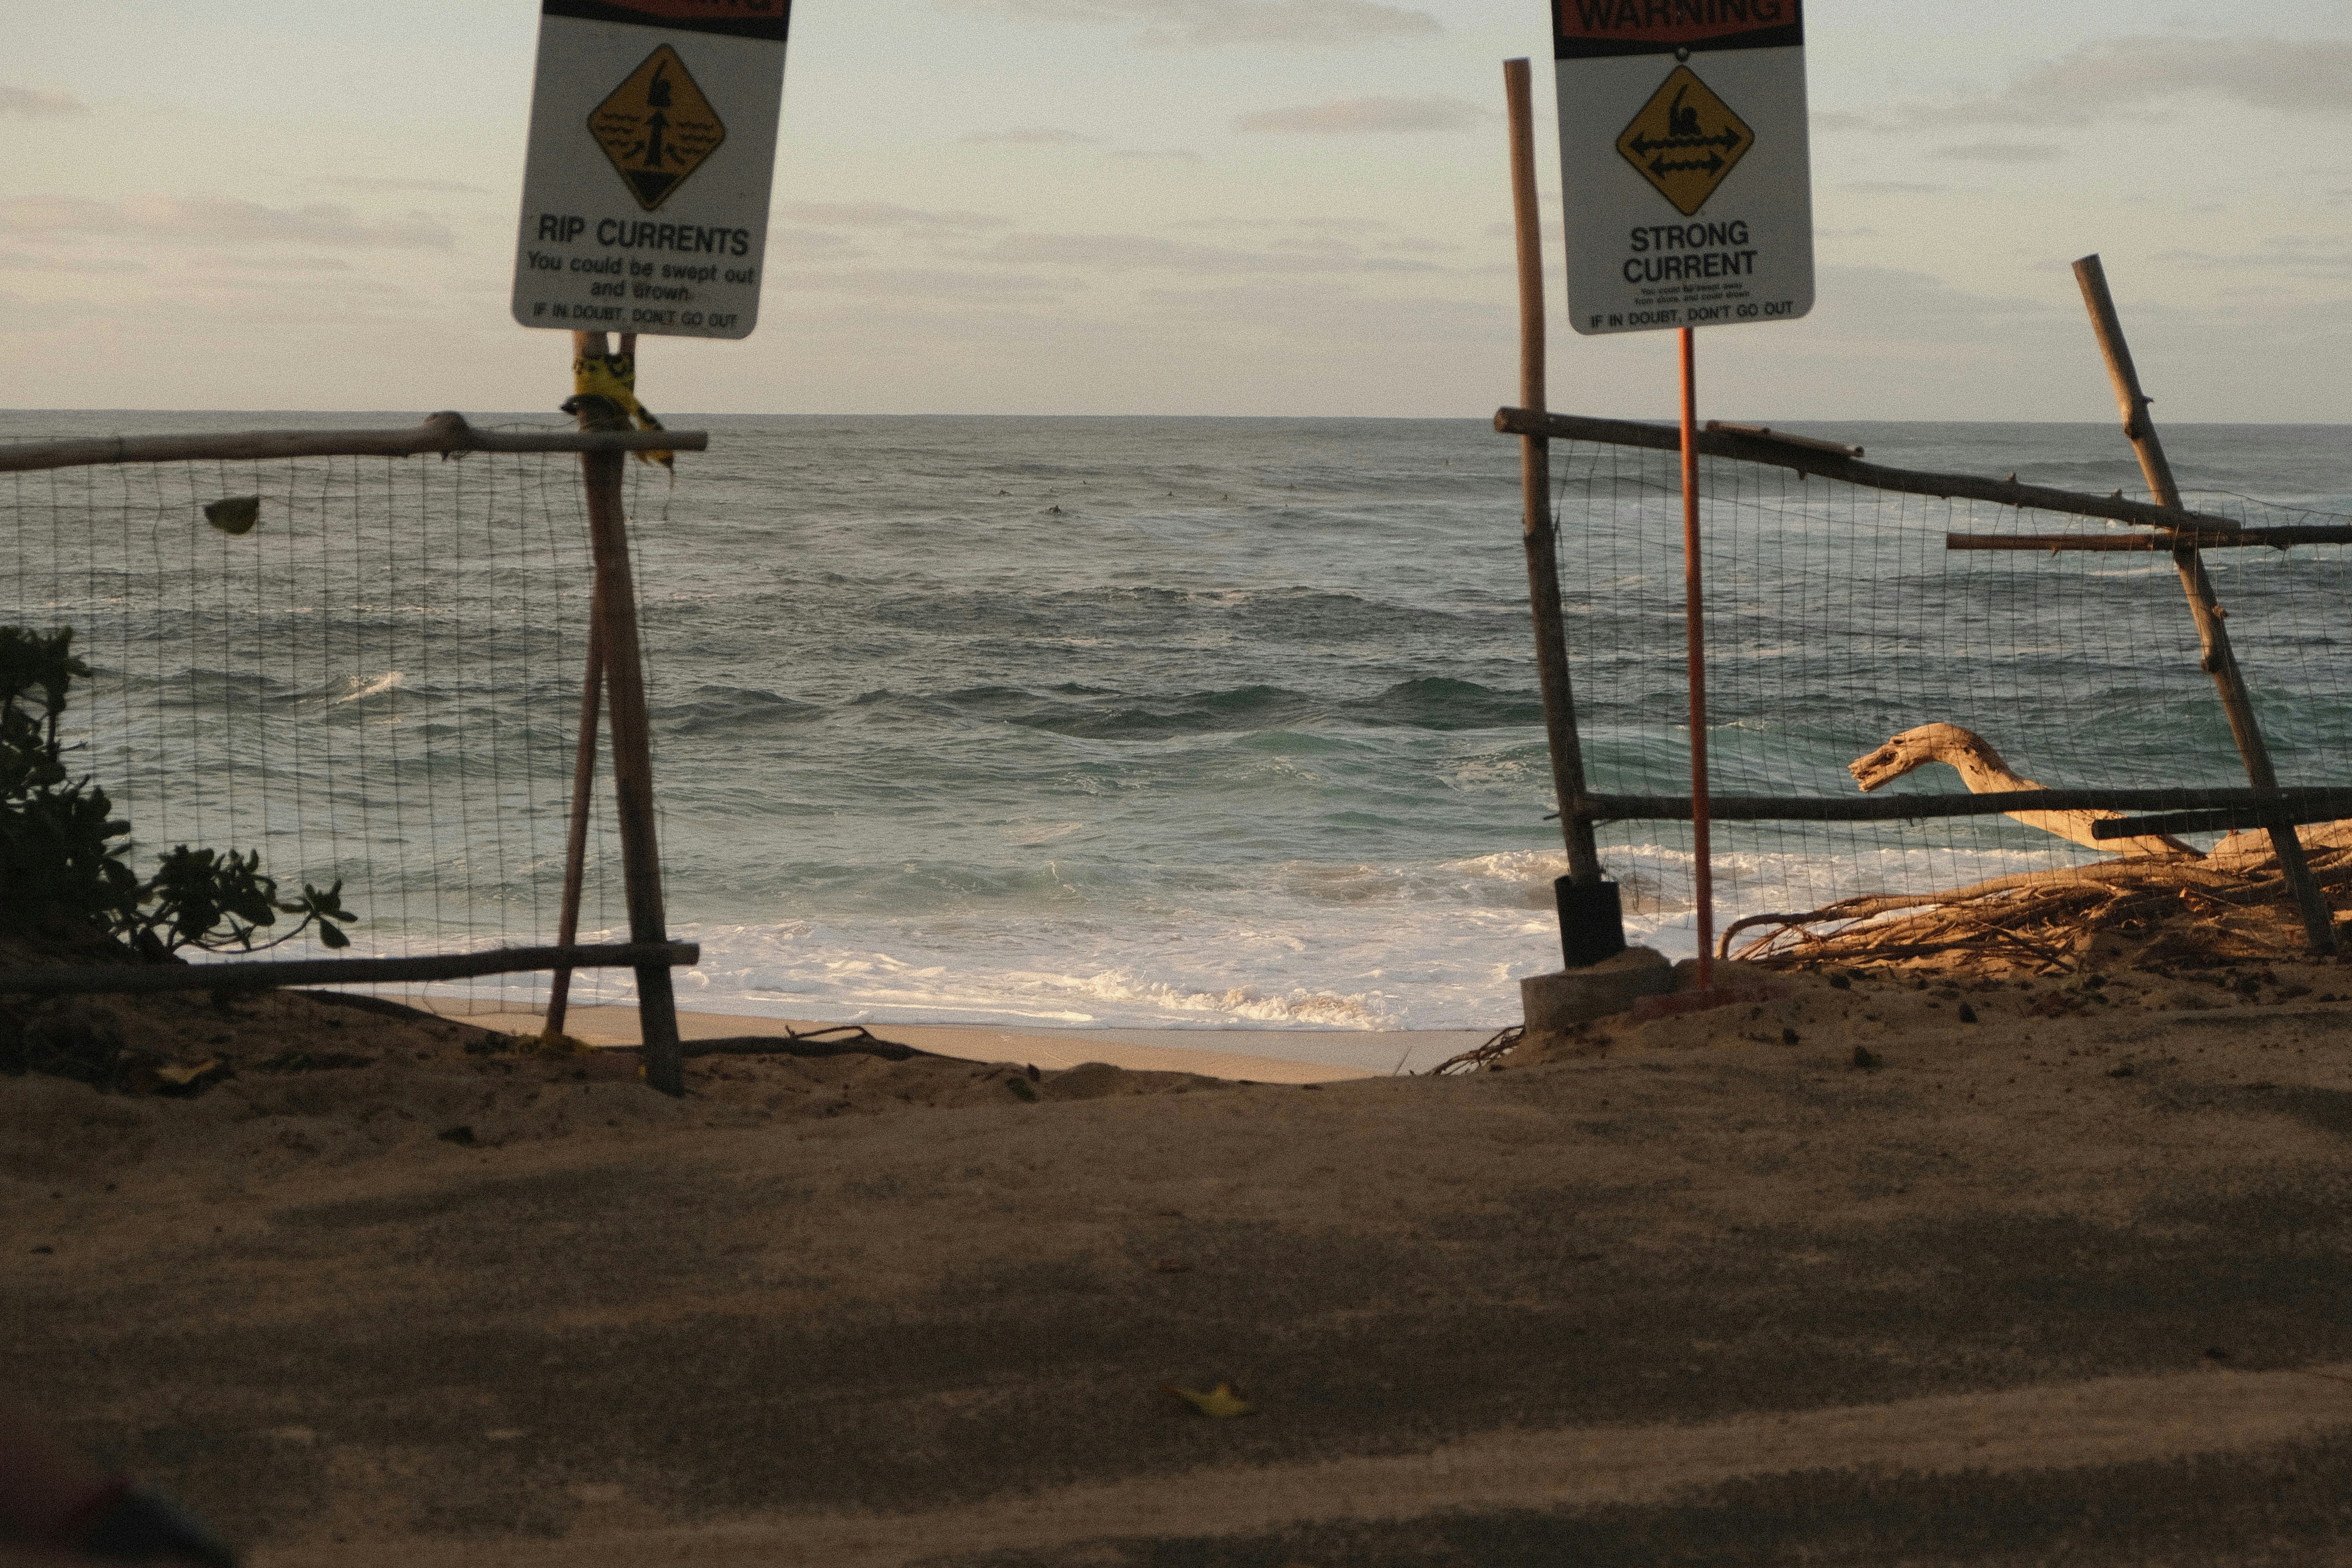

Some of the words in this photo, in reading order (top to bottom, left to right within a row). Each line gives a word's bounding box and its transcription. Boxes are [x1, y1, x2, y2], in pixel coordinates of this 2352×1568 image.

[1578, 0, 1782, 31] WARNING
[538, 214, 585, 243] RIP
[596, 218, 750, 256] CURRENTS
[1630, 220, 1748, 252] STRONG
[528, 250, 562, 272] You
[570, 256, 623, 275] could
[630, 258, 653, 277] be
[661, 264, 717, 283] swept
[724, 266, 755, 284] out
[1622, 250, 1758, 283] CURRENT
[590, 279, 626, 298] and
[533, 303, 547, 316] IF
[552, 304, 567, 319] IN
[681, 311, 702, 326] GO
[708, 312, 738, 328] OUT
[1590, 314, 1602, 328] IF
[1608, 313, 1623, 327] IN
[1687, 305, 1731, 321] DON'T
[1736, 303, 1758, 318] GO
[1764, 301, 1794, 316] OUT
